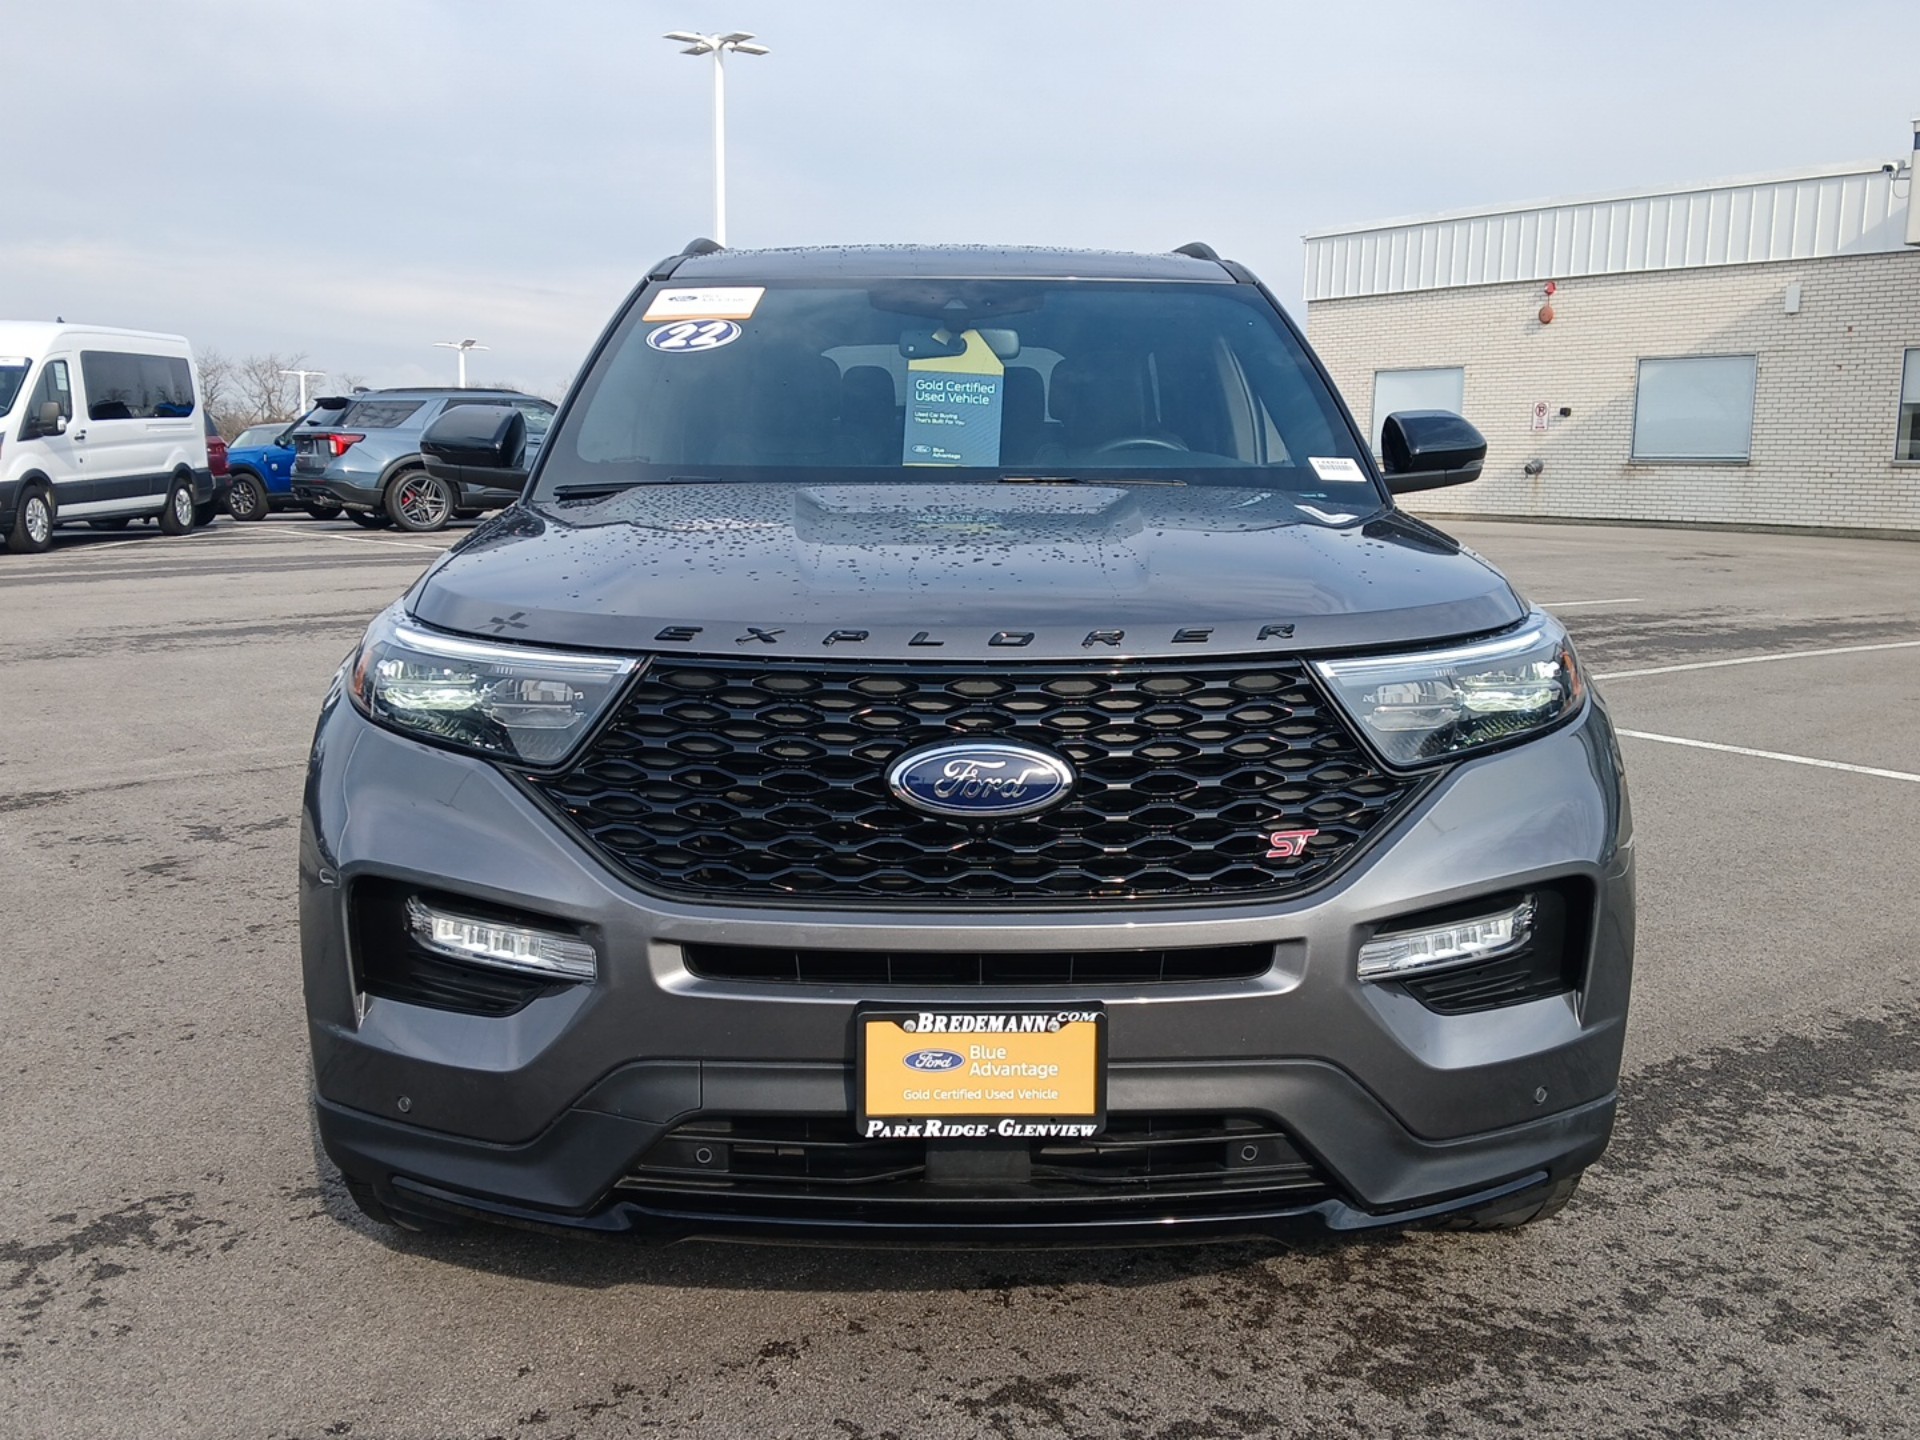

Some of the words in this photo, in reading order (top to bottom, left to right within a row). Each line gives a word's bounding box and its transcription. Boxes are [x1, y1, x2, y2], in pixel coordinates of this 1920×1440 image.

[659, 321, 729, 348] 22
[915, 379, 944, 391] Gold
[946, 381, 996, 394] Certified
[915, 391, 945, 402] Used
[948, 392, 990, 405] Vehicle
[654, 623, 1296, 648] EXPLORER
[934, 759, 1027, 798] Ford
[1265, 828, 1319, 858] ST
[916, 1012, 1049, 1033] BREDEMANN
[915, 1051, 953, 1069] Ford
[969, 1045, 1007, 1060] Blue
[969, 1062, 1059, 1079] Advantage
[903, 1089, 930, 1100] Gold
[933, 1089, 982, 1100] Certified
[985, 1089, 1014, 1100] Used
[1018, 1089, 1058, 1100] Vehicle
[865, 1120, 922, 1138] PARK
